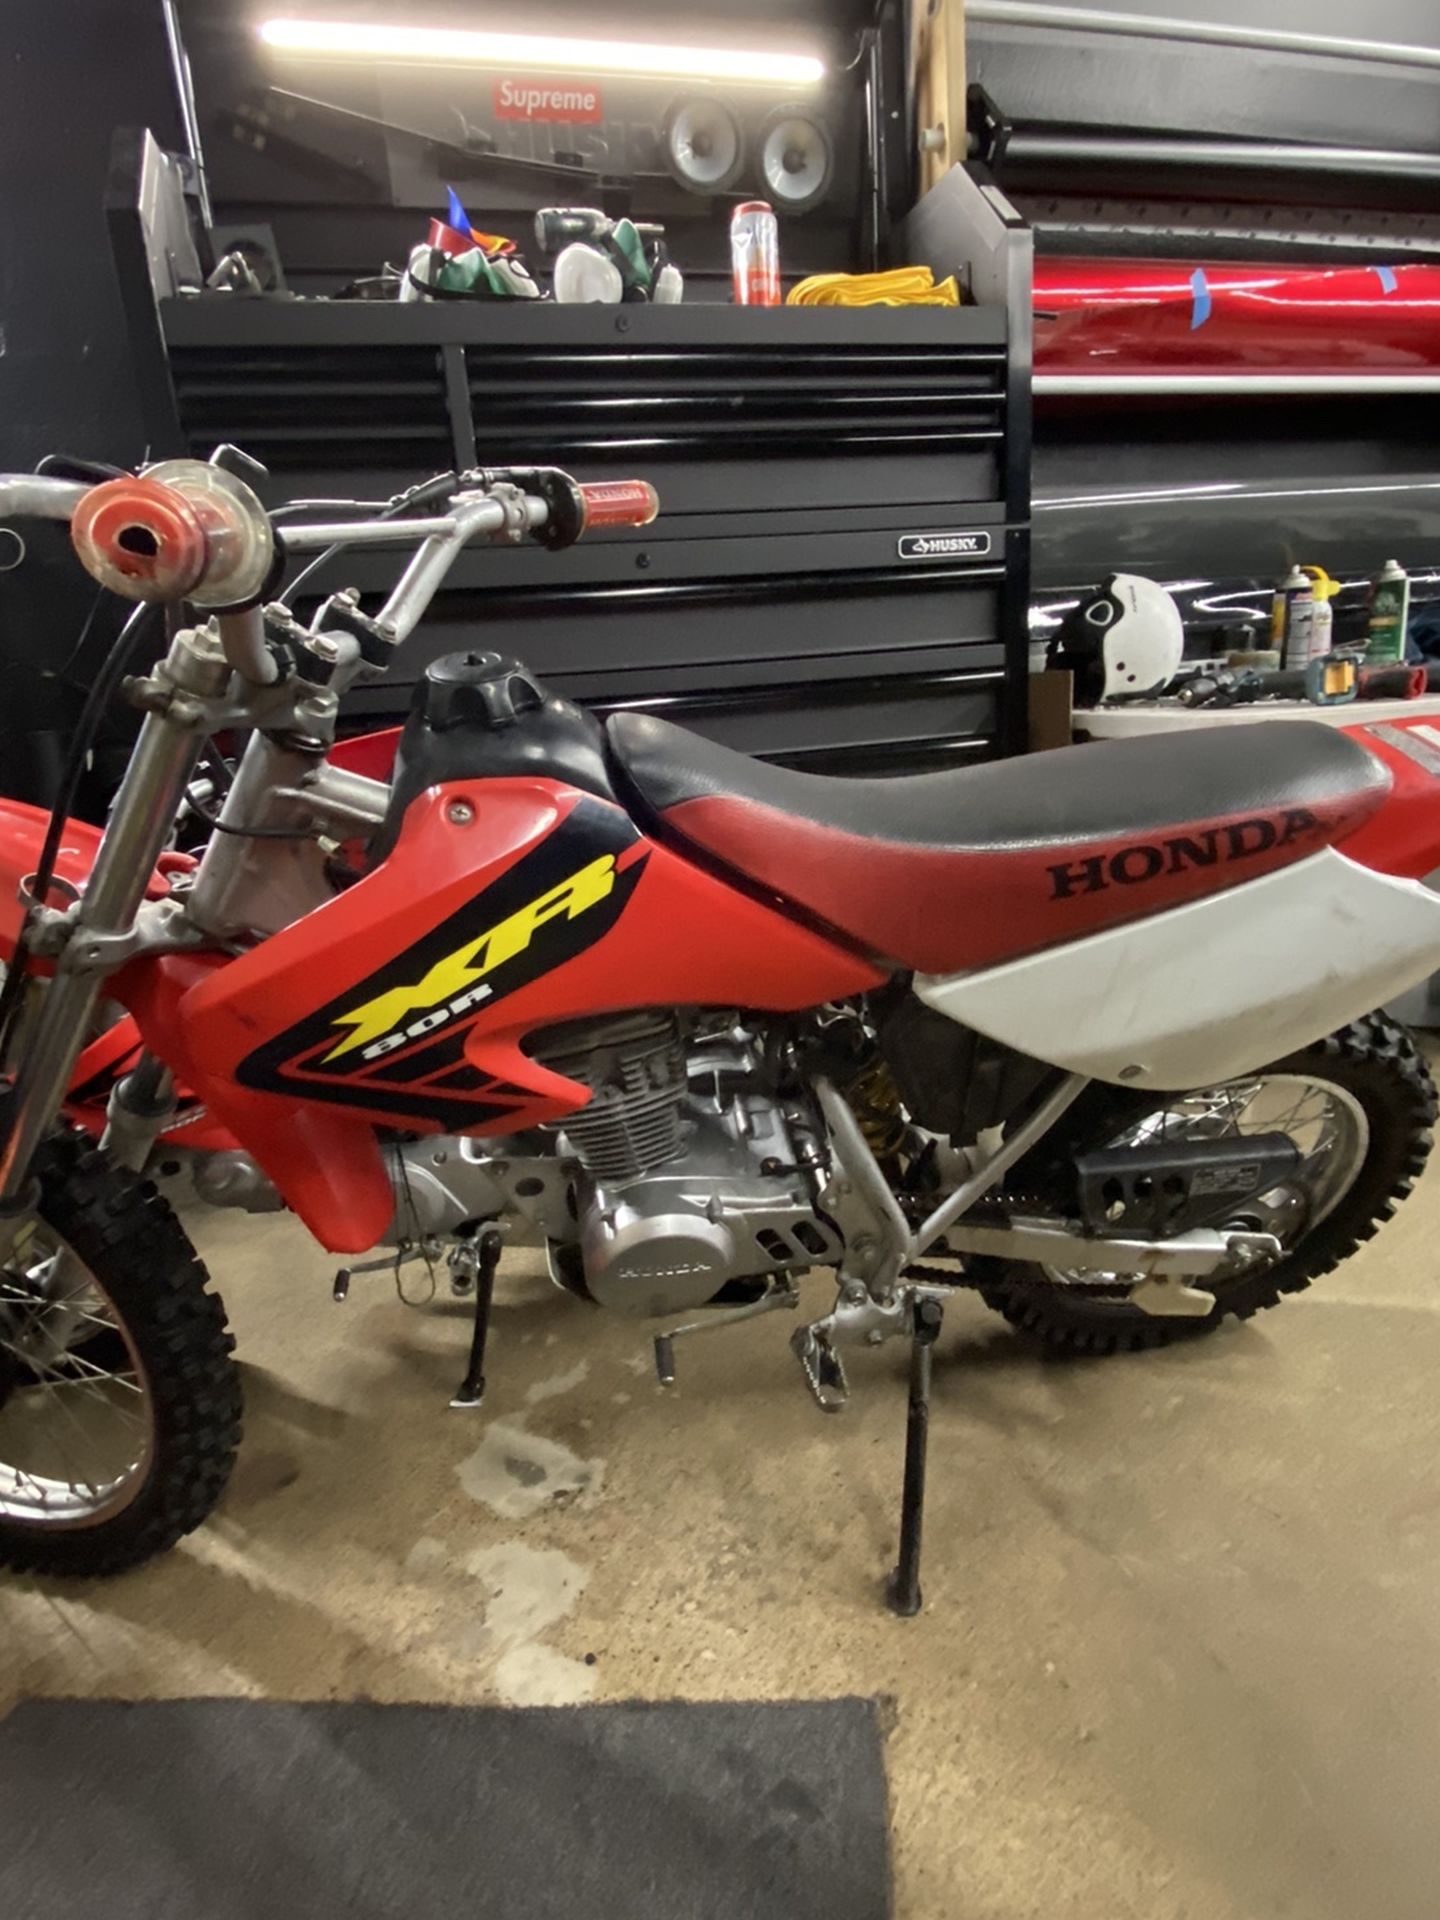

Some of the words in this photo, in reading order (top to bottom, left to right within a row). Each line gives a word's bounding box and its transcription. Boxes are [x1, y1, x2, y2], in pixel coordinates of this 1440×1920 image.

[500, 80, 596, 115] Supreme
[1046, 807, 1329, 900] HONDA
[361, 983, 493, 1060] 80R
